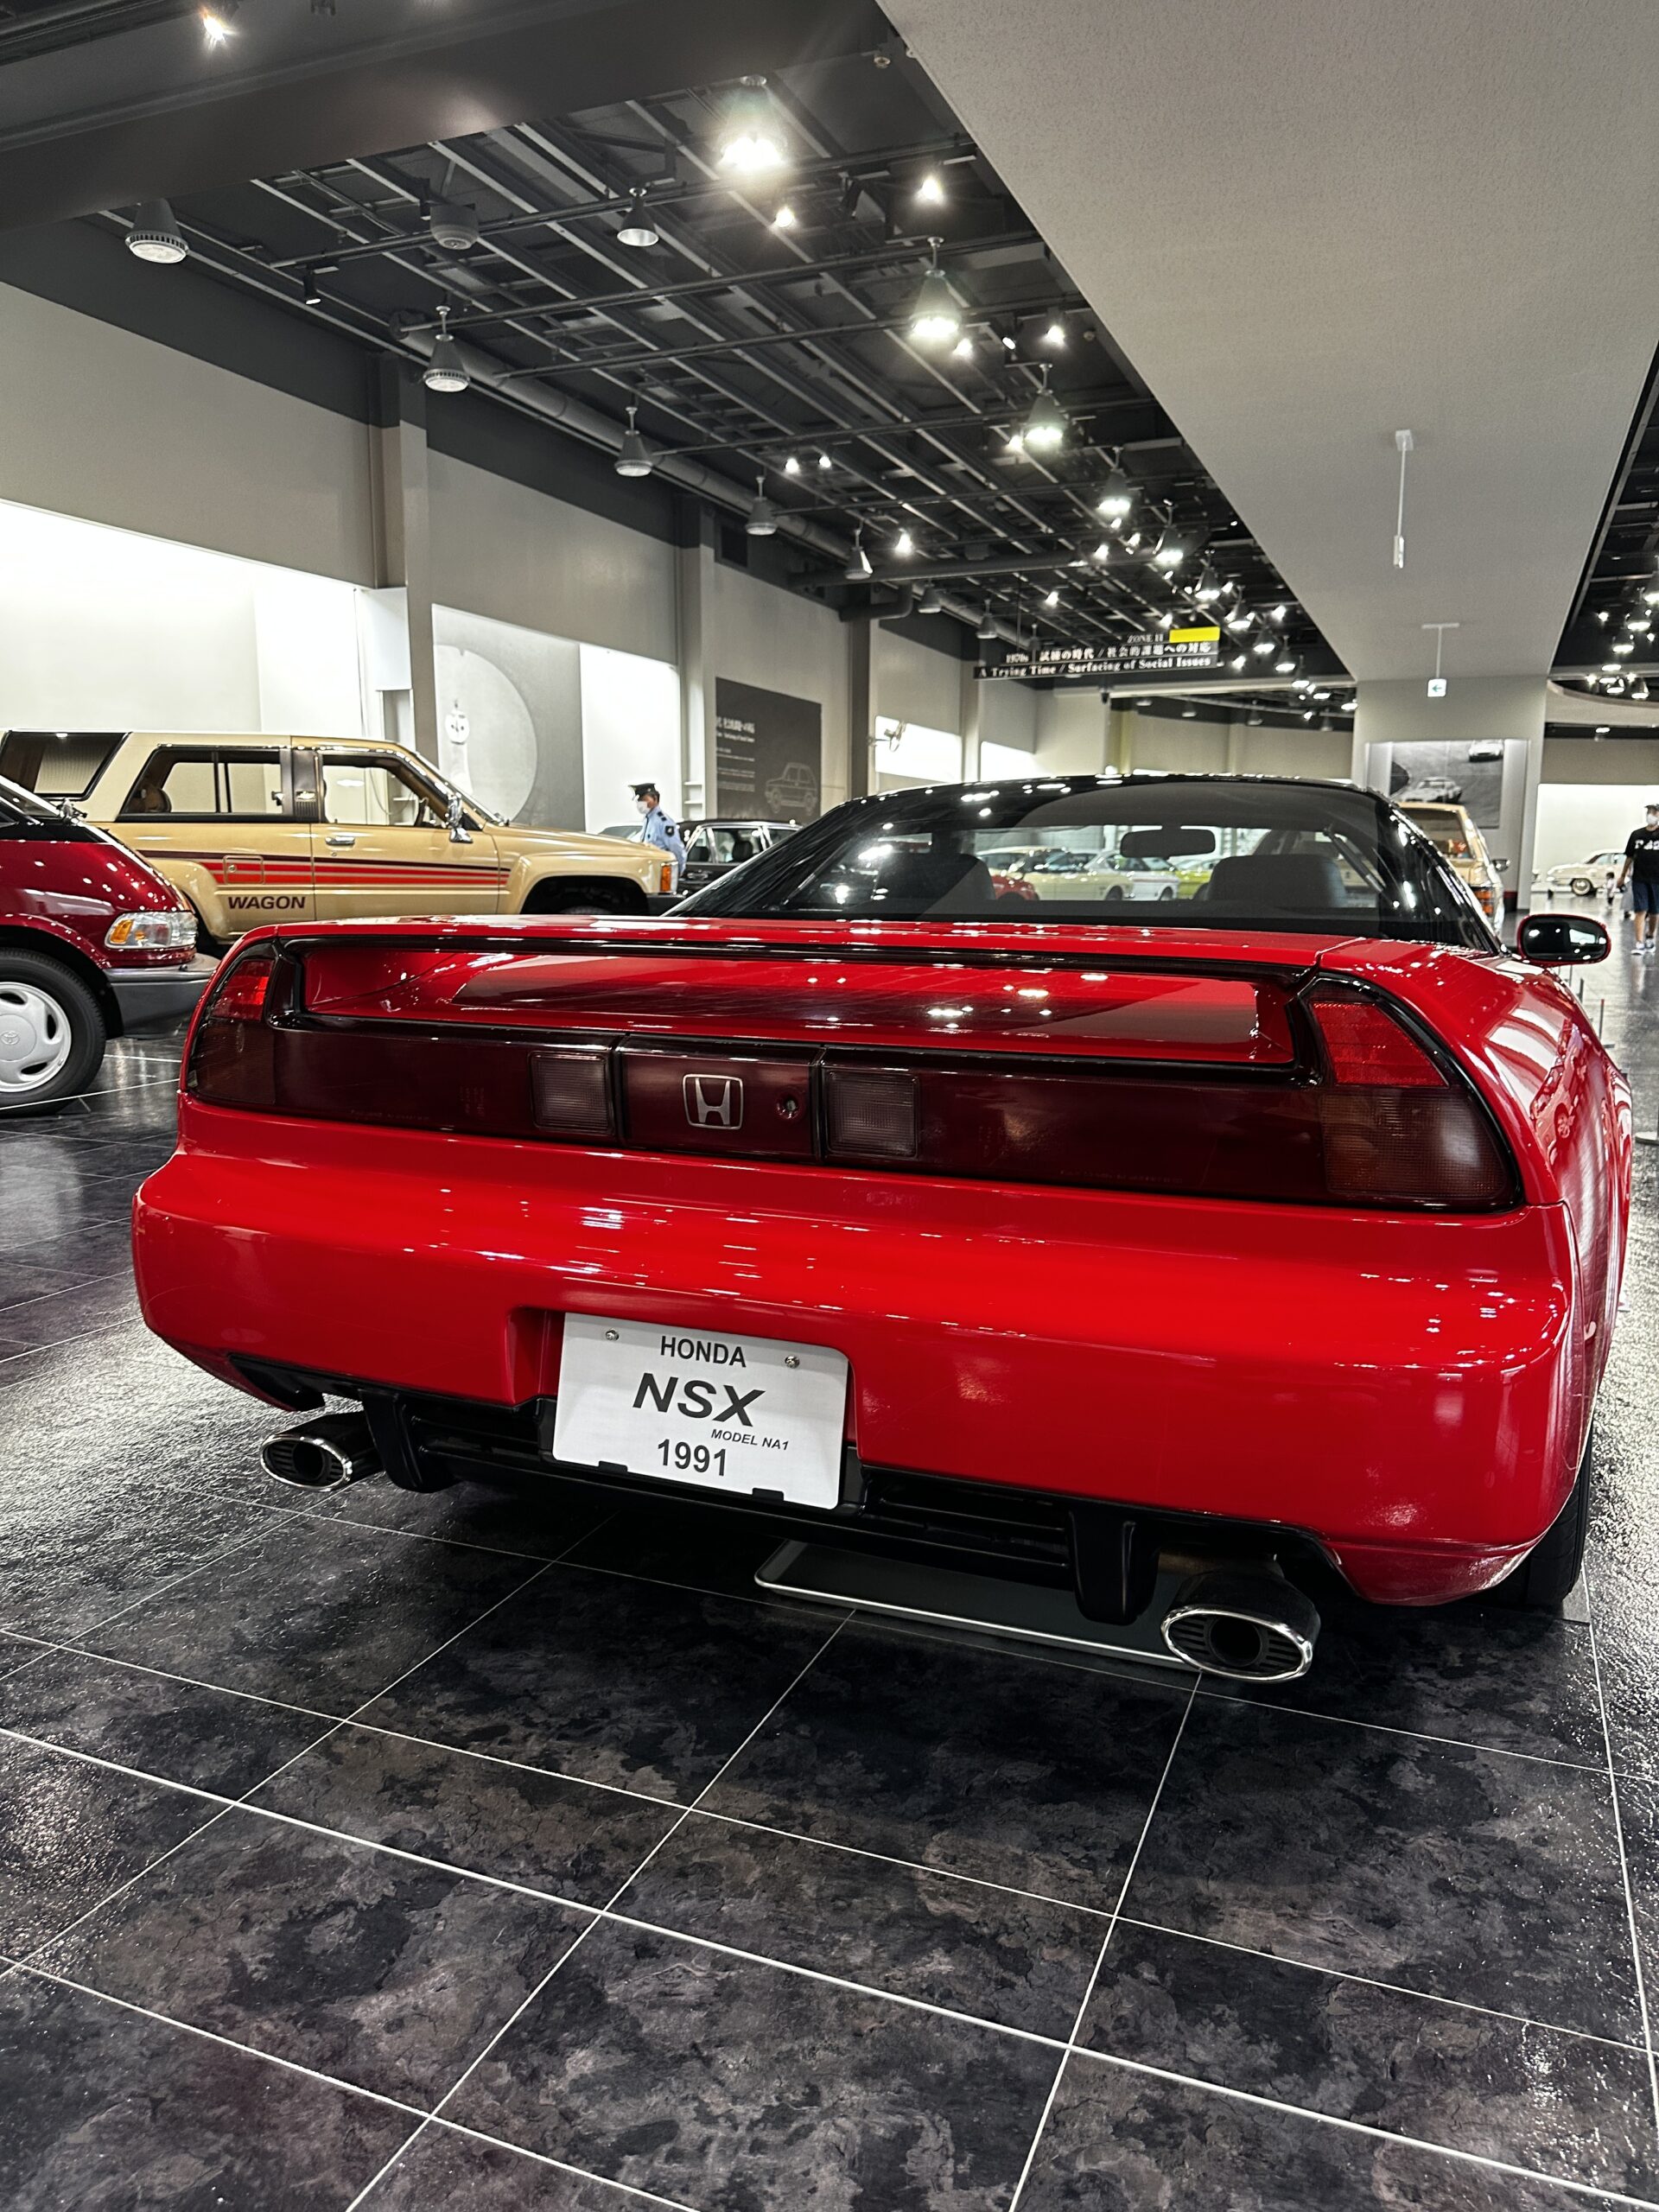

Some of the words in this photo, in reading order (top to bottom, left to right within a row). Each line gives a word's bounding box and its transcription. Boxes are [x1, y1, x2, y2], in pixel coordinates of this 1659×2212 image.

[991, 665, 1027, 678] Trying
[1029, 664, 1056, 675] Time
[1068, 661, 1121, 673] Surfacing
[1123, 659, 1136, 670] of
[1139, 658, 1173, 669] Social
[1176, 657, 1211, 667] Issues
[227, 896, 306, 910] WAGON
[660, 1335, 747, 1368] HONDA
[632, 1372, 766, 1427] NSX
[710, 1428, 758, 1446] MODEL
[761, 1437, 790, 1451] NA1
[657, 1439, 727, 1477] 1991
